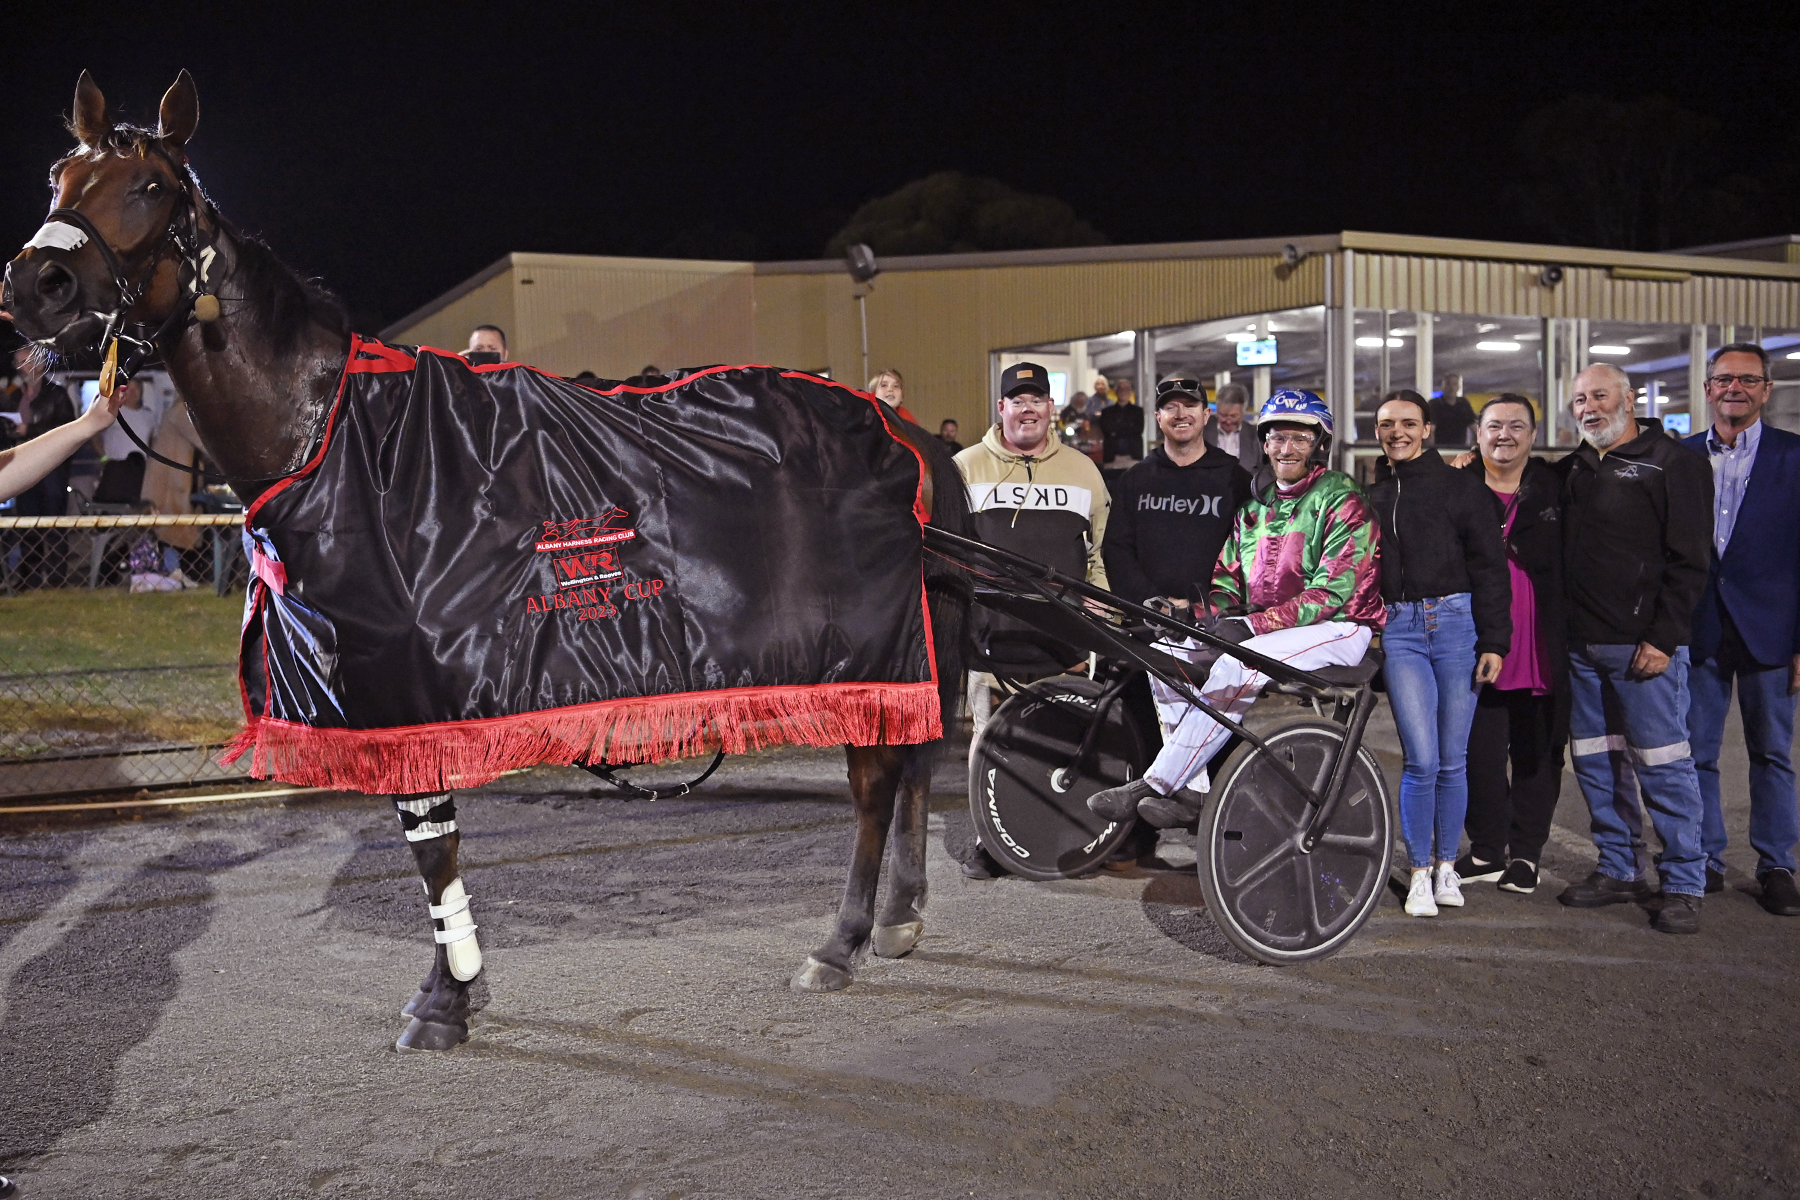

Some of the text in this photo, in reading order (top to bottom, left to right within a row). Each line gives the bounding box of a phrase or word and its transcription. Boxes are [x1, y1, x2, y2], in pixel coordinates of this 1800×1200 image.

[1137, 493, 1200, 515] Hurley
[536, 530, 635, 550] ALBANY HARNESS RACING CLUB
[560, 576, 594, 587] Wellington
[527, 579, 664, 613] ALBANY CUP
[578, 604, 617, 620] 2023
[1020, 694, 1098, 719] CRIM
[987, 768, 1031, 859] CORIMA
